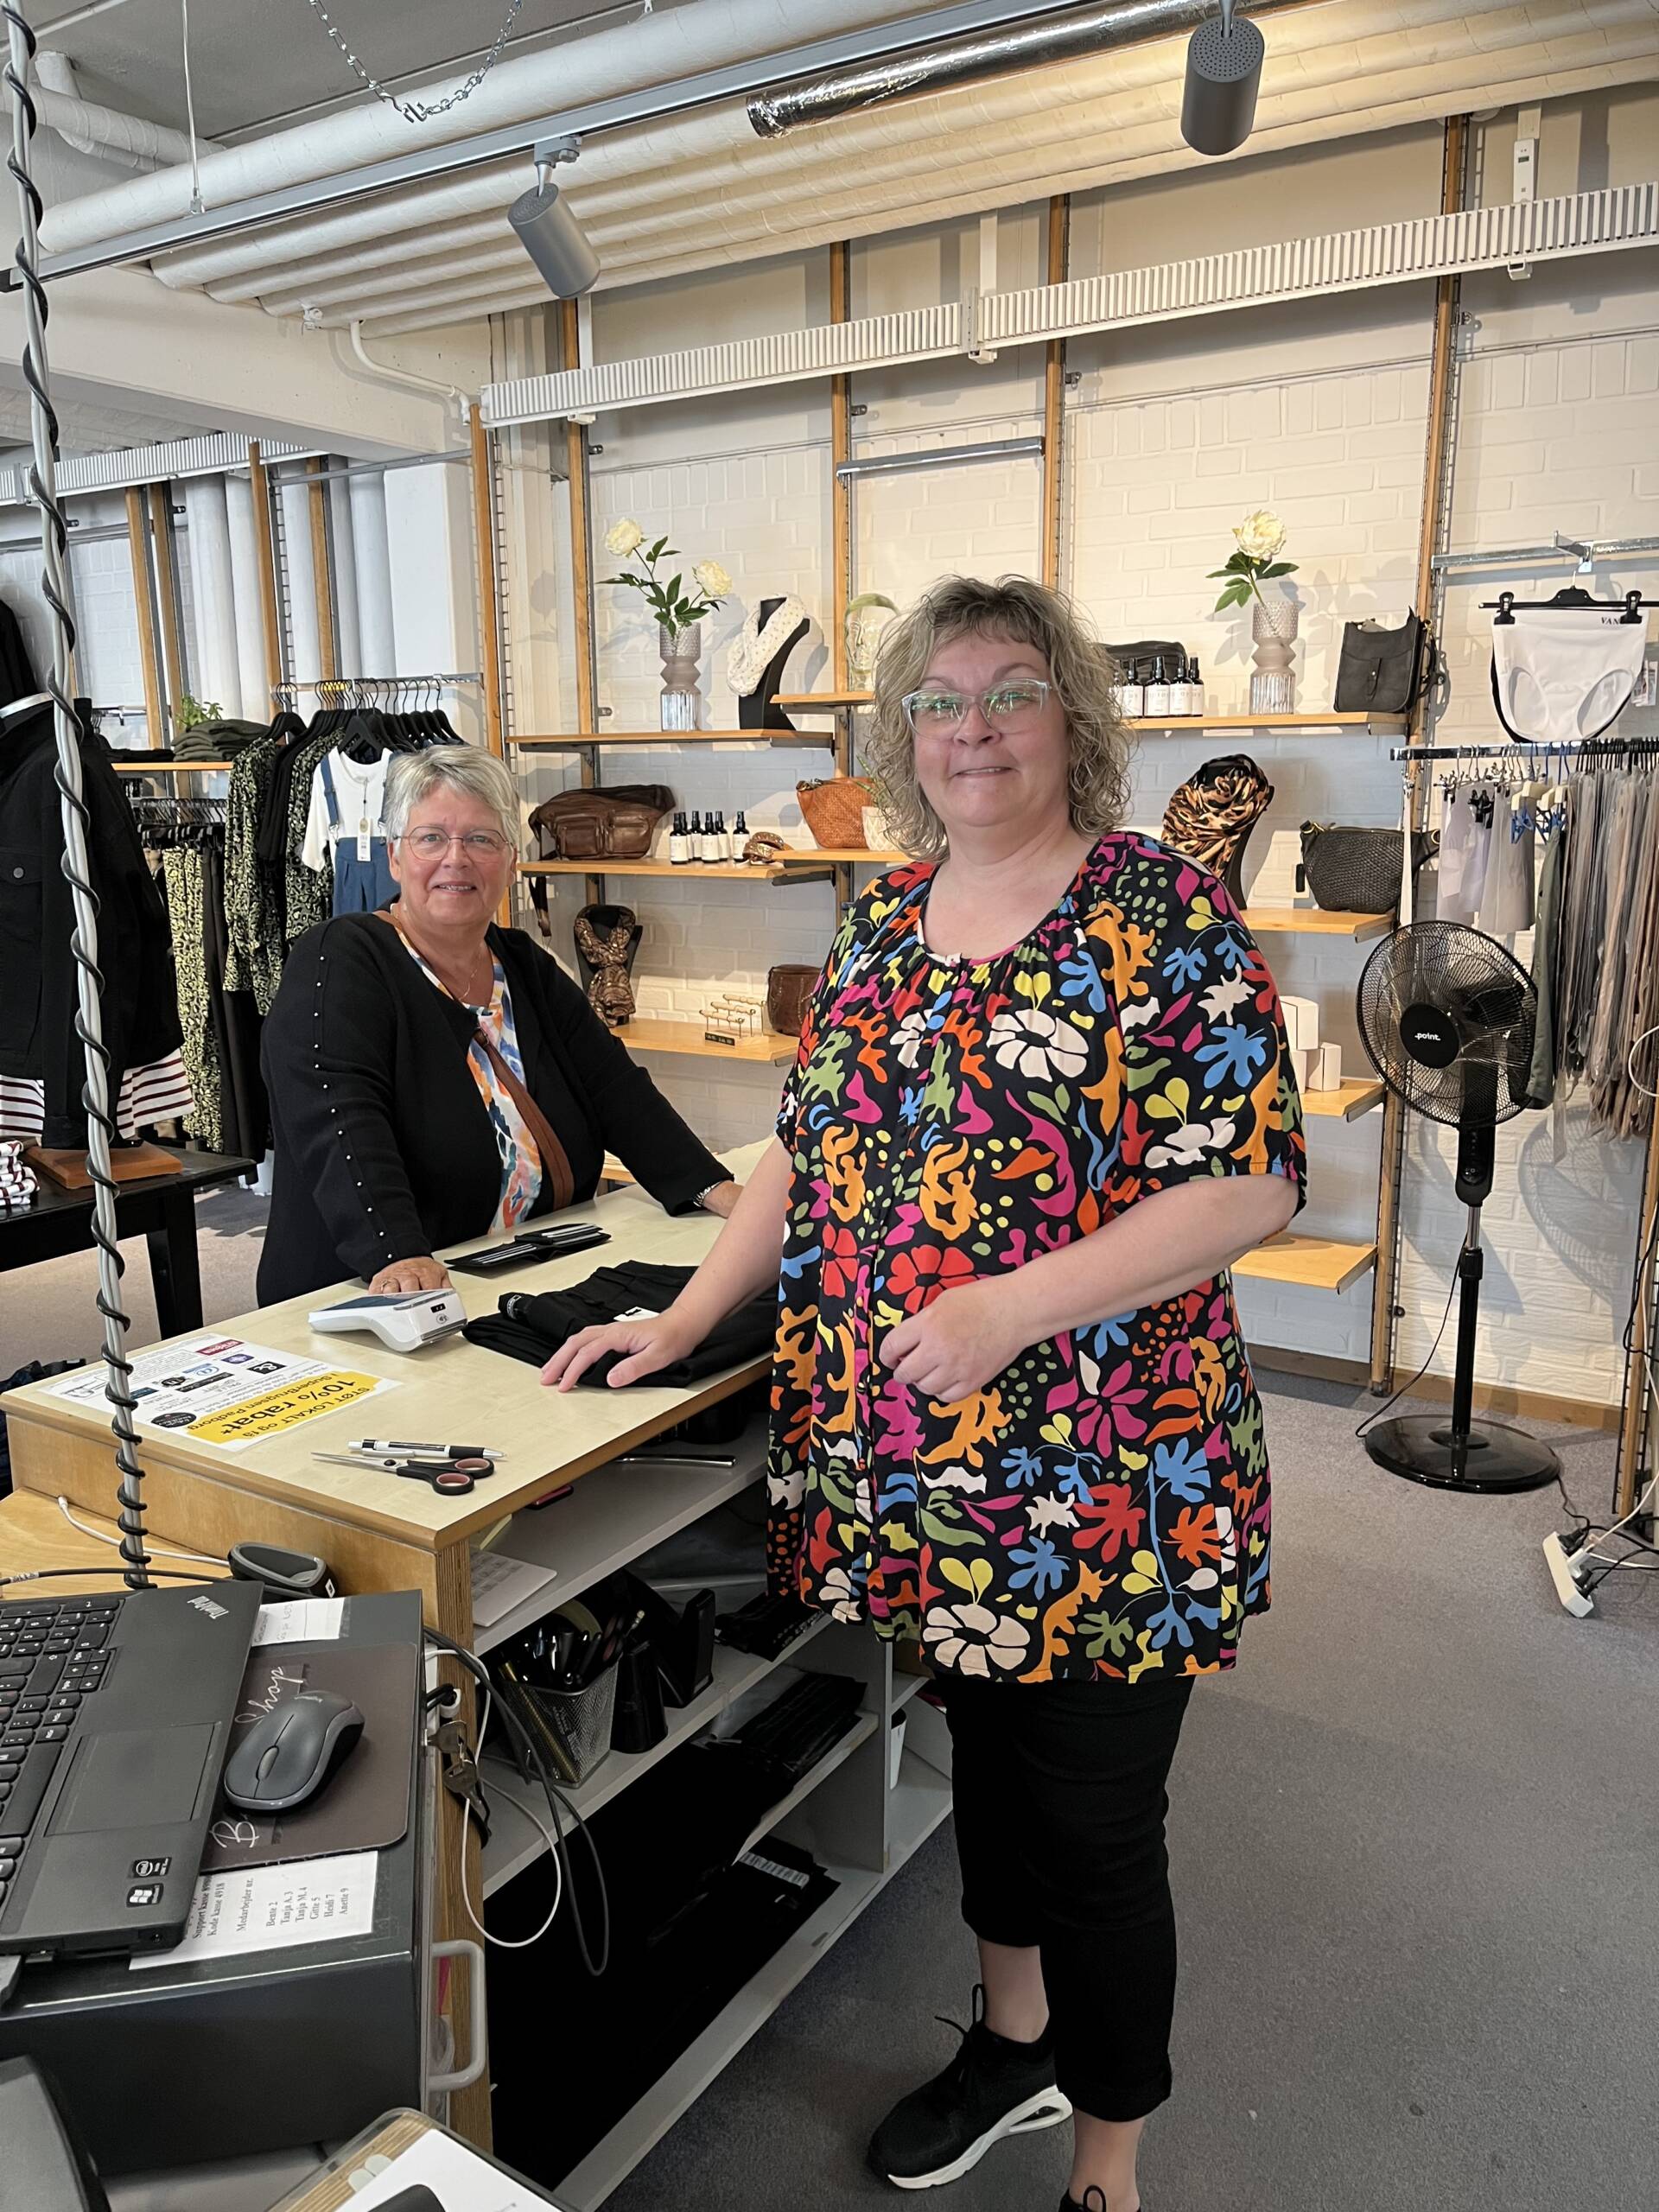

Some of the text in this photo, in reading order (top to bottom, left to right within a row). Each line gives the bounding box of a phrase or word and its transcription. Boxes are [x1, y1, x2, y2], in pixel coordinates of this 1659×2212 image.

[1414, 1033, 1441, 1041] point
[245, 1375, 333, 1408] SuperBrugsen
[298, 1380, 356, 1401] 10%
[188, 1402, 245, 1430] Padborg
[282, 1402, 335, 1423] LOKALT
[236, 1890, 252, 1931] Medarbejder
[280, 1905, 293, 1924] Tanja
[295, 1903, 308, 1923] Tanja
[309, 1903, 320, 1919] Gitte
[324, 1899, 334, 1917] Heidi
[339, 1894, 349, 1915] Anette
[193, 1910, 207, 1939] Support
[207, 1918, 219, 1936] Kode
[266, 1908, 276, 1926] Bente
